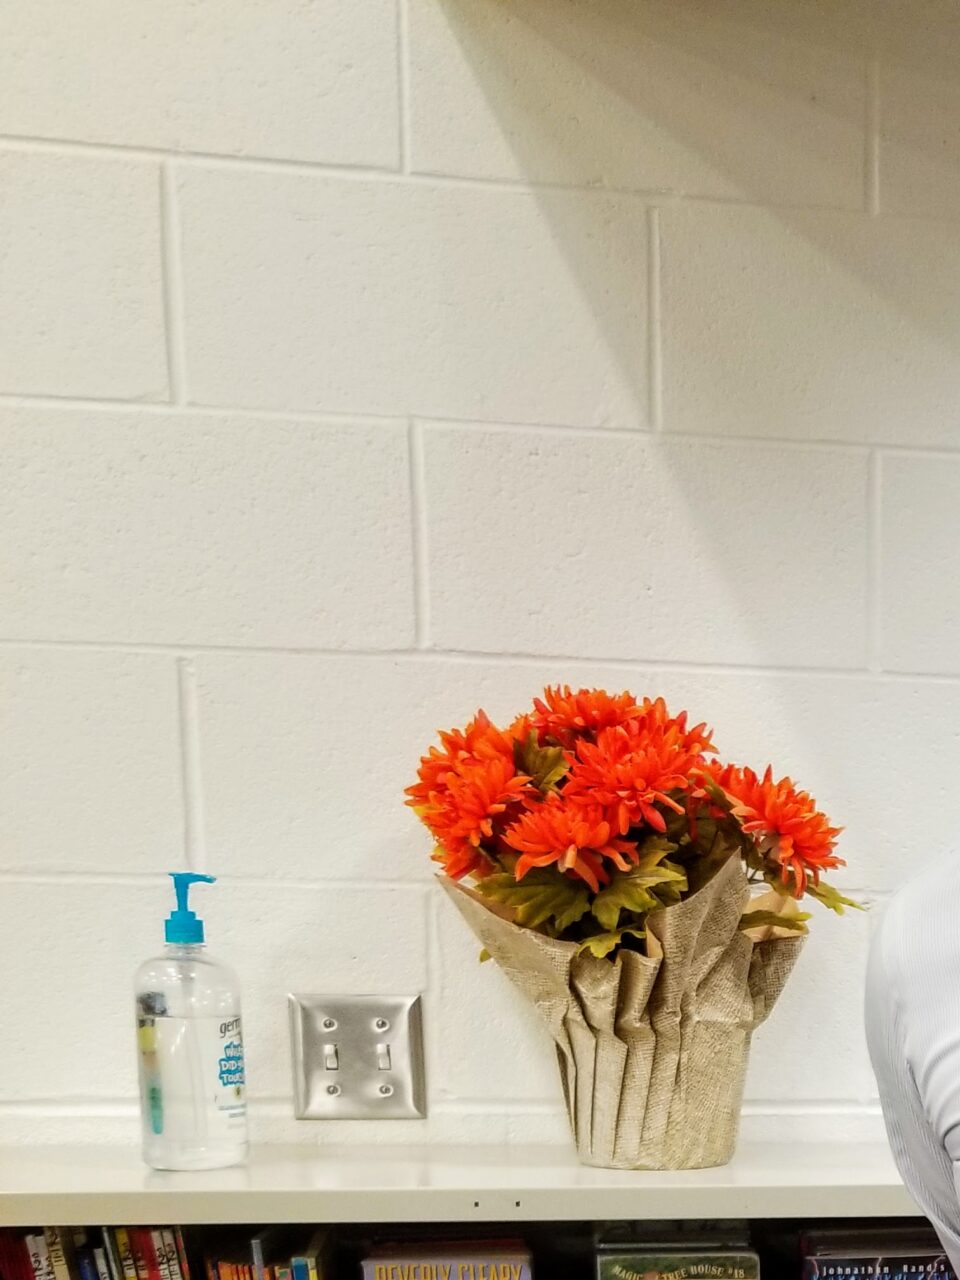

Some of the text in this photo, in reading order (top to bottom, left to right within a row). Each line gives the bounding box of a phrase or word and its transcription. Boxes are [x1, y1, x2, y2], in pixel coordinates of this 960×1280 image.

[612, 1265, 644, 1280] MAGIC
[661, 1268, 688, 1280] TREE
[690, 1265, 724, 1276] HOUSE
